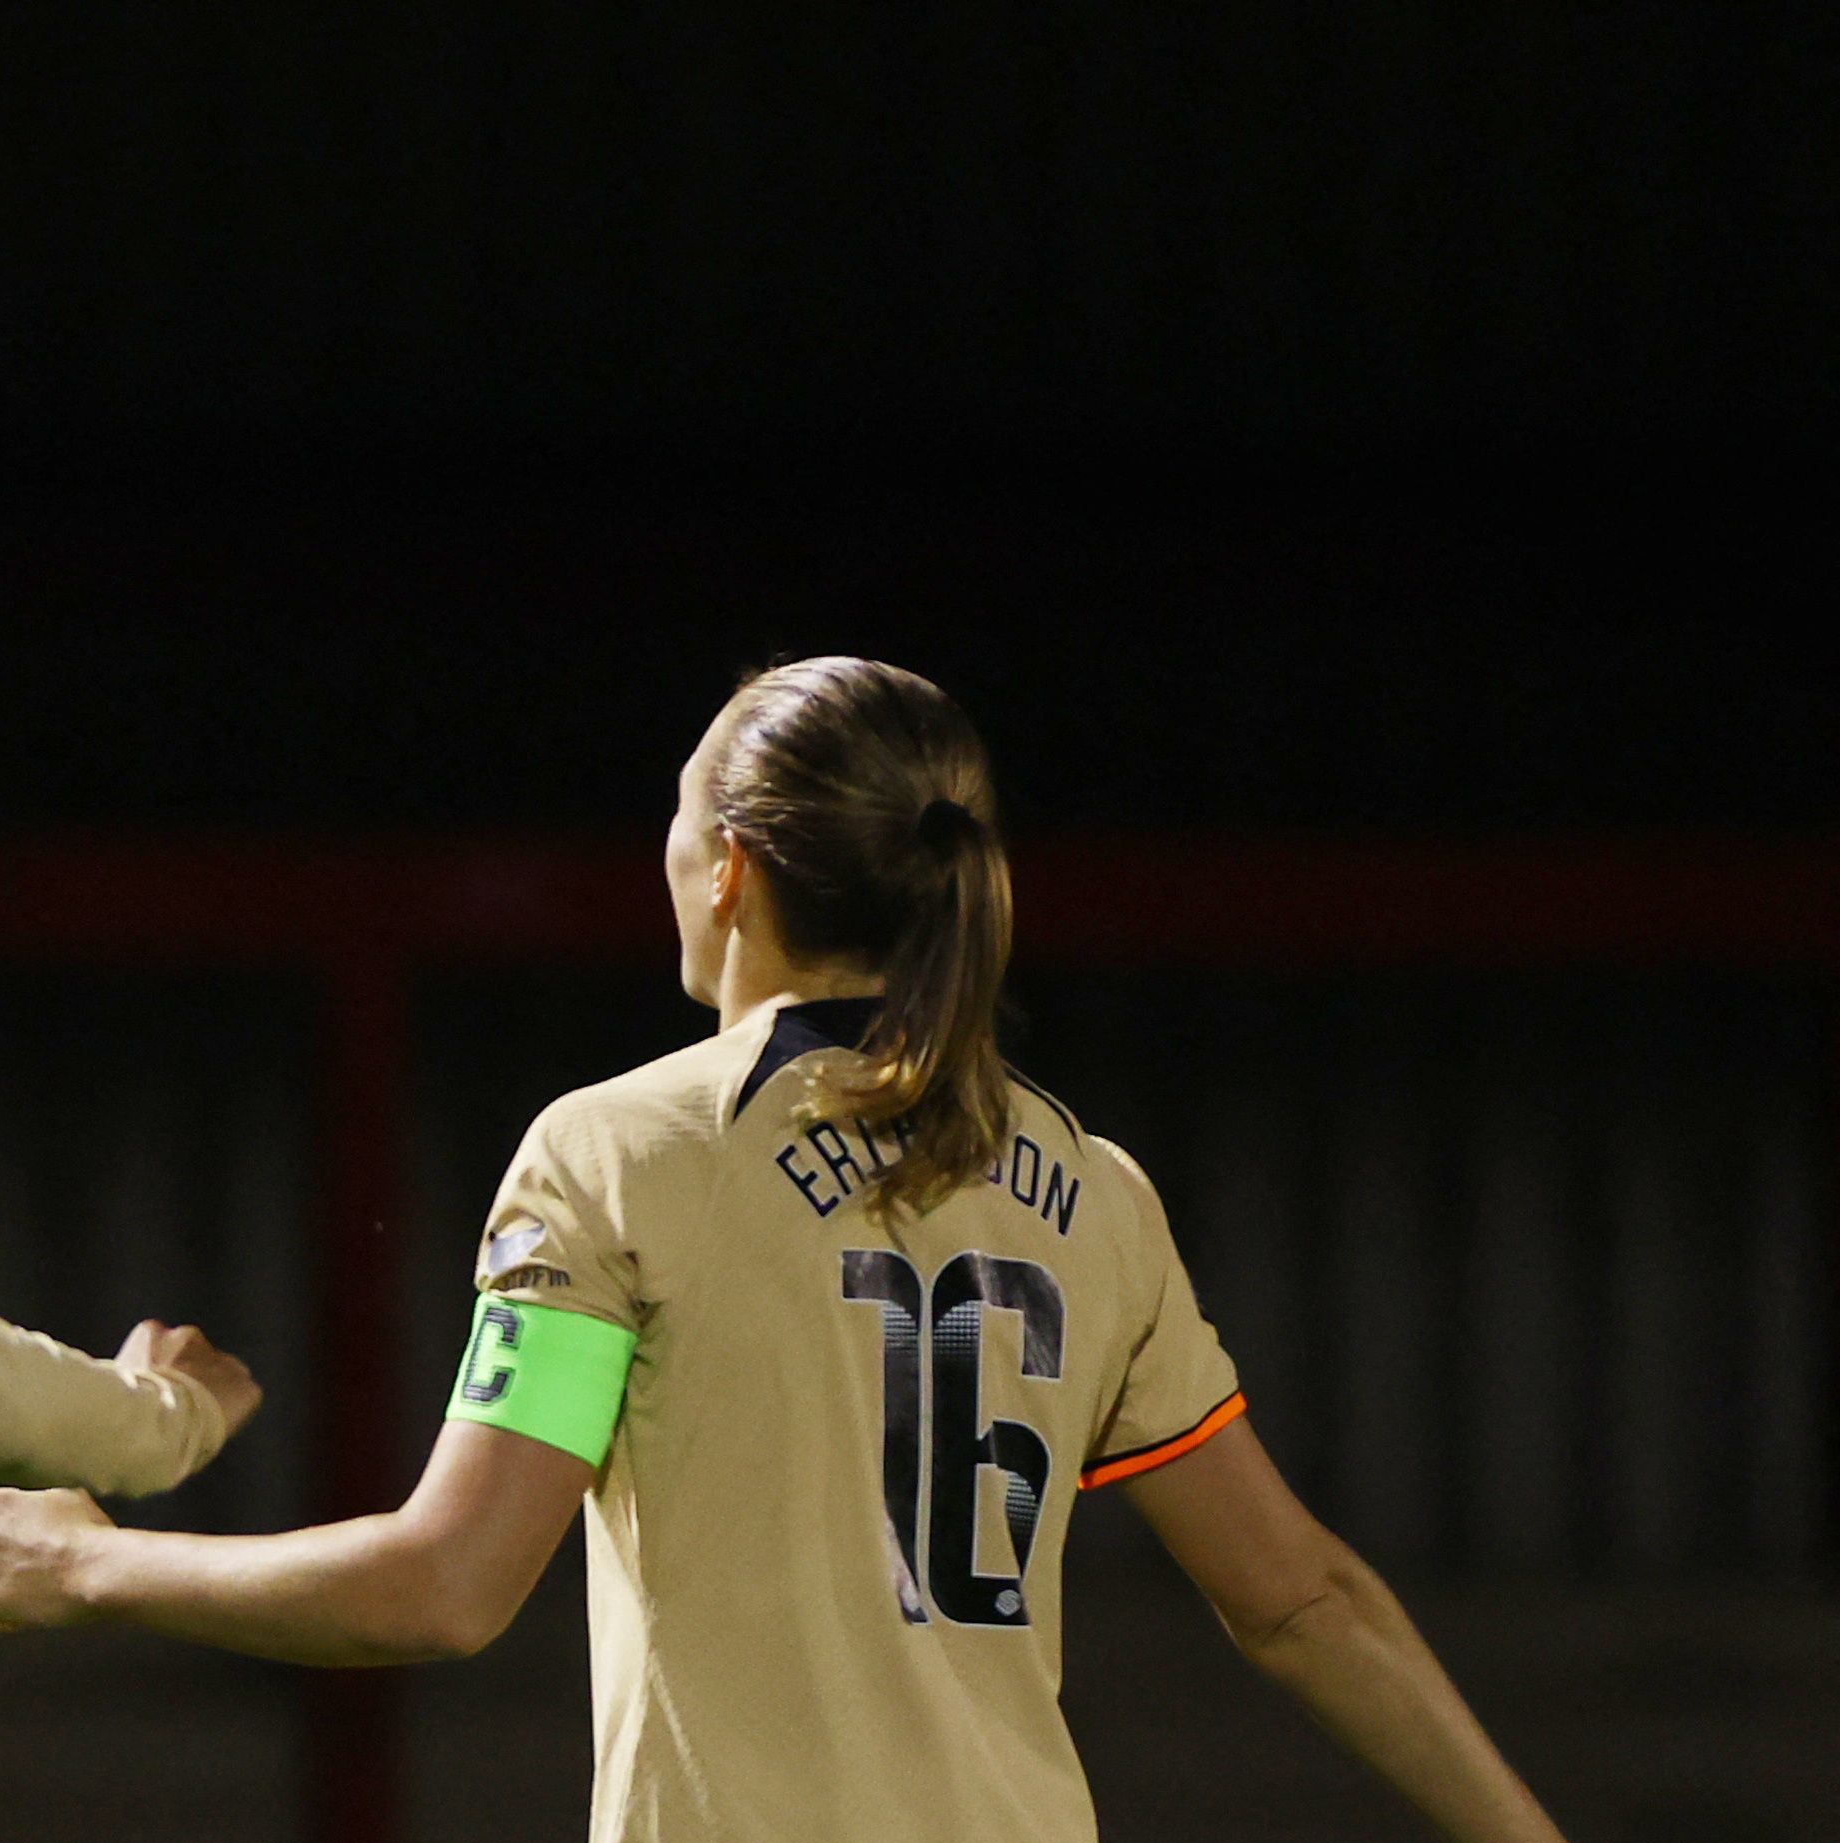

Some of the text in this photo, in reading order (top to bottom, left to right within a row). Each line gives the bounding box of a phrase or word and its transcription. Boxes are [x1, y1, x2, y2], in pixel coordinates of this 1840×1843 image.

[775, 1117, 1080, 1236] ERION
[462, 1306, 524, 1404] C
[841, 1248, 1067, 1627] 16
